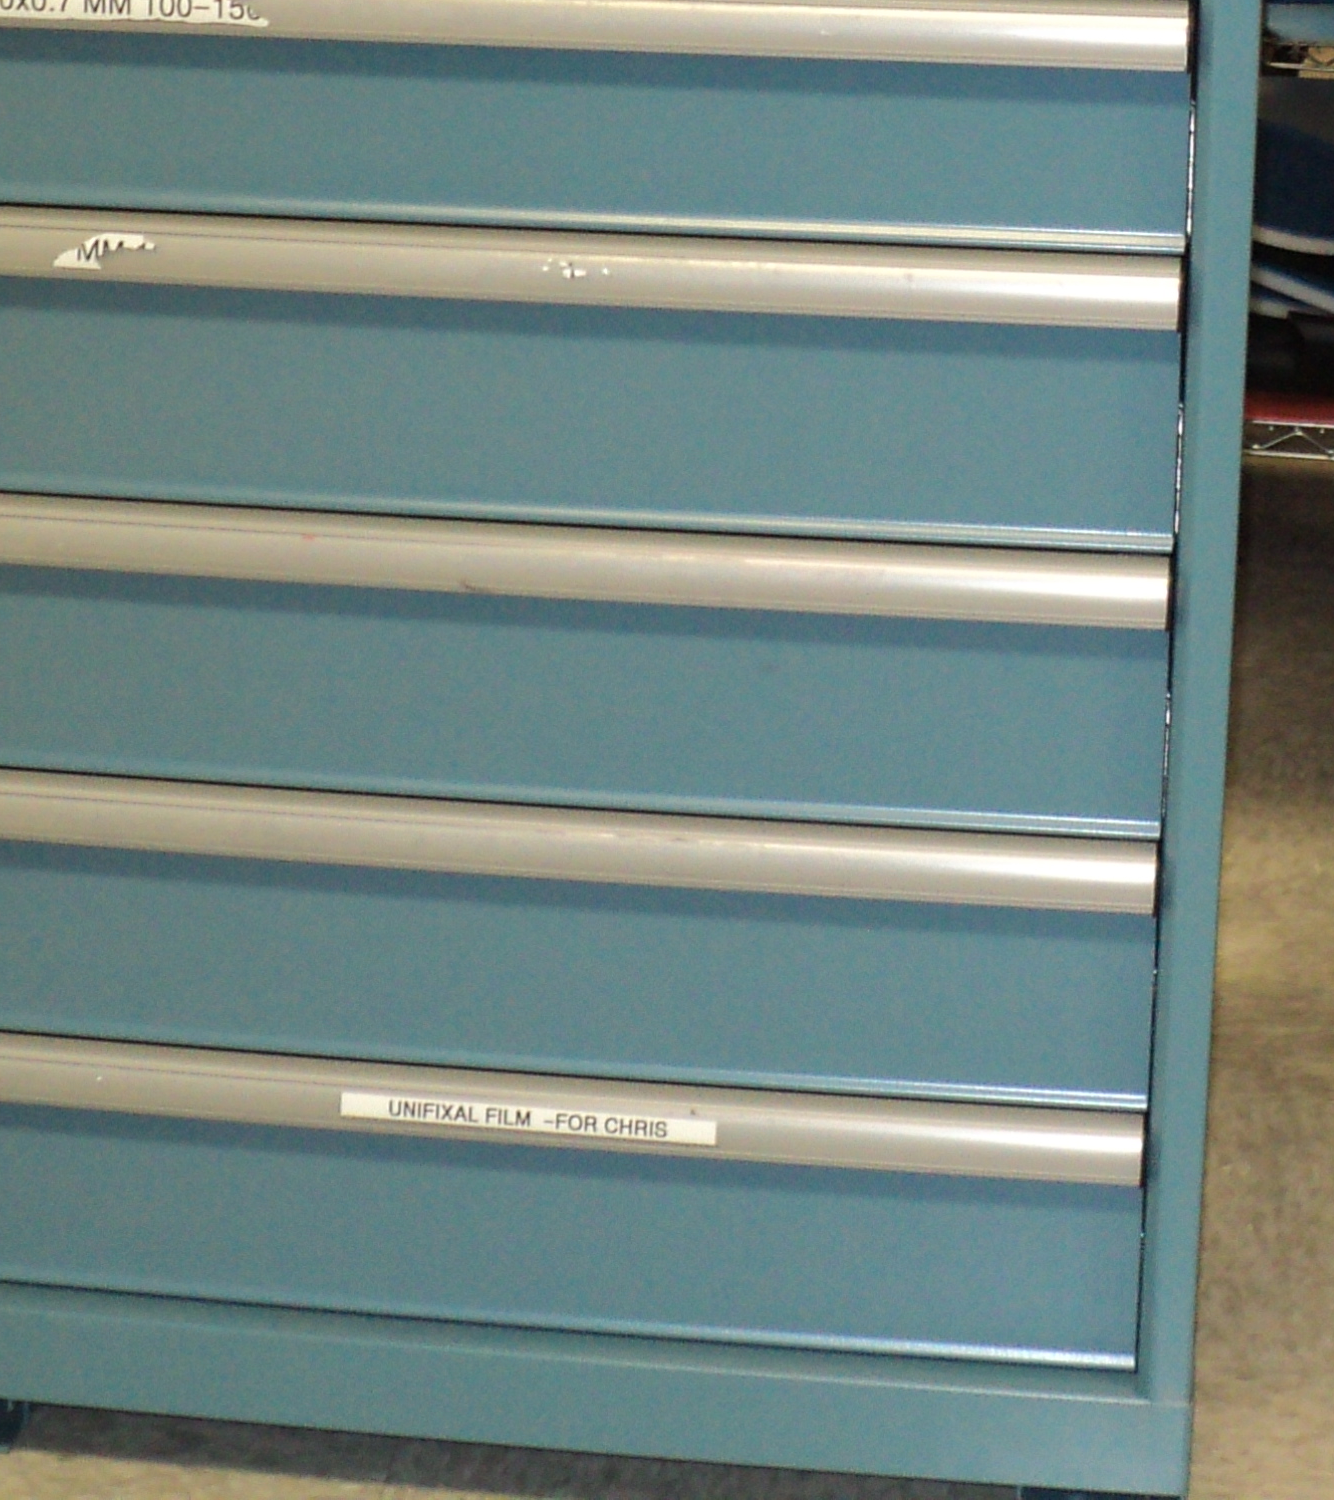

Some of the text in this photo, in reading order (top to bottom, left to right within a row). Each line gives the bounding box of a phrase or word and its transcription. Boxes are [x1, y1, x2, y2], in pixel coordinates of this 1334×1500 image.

[387, 1099, 668, 1139] UNIFIXAL FILM -FOR CHRIS
